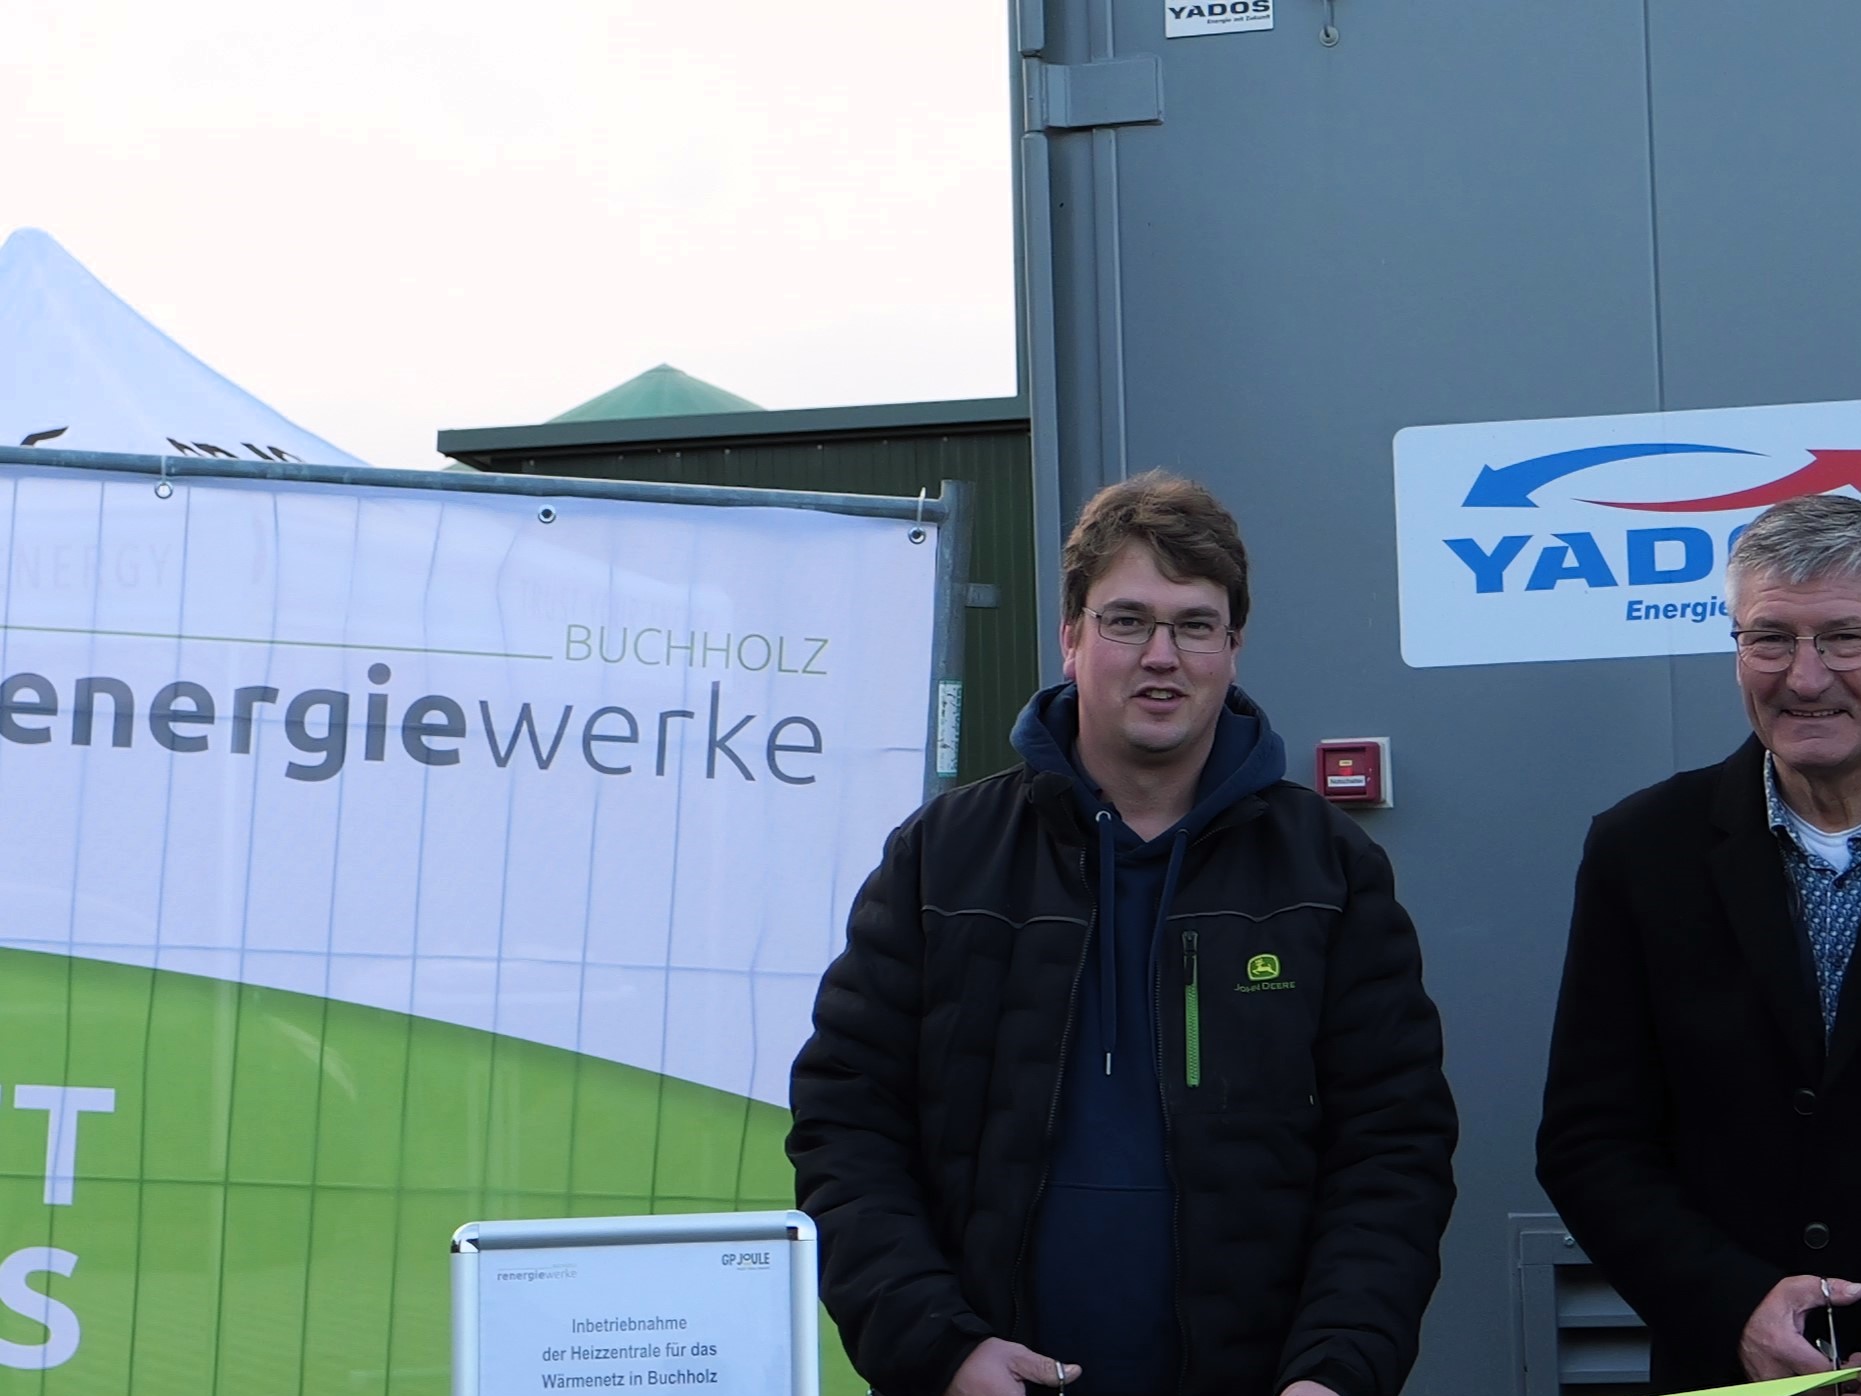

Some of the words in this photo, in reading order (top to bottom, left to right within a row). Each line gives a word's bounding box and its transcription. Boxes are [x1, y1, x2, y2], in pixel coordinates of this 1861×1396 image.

[1168, 0, 1270, 19] YADOS
[1442, 524, 1749, 594] YAD
[564, 623, 830, 676] BUCHHOLZ
[0, 662, 824, 786] energiewerke
[1262, 981, 1296, 991] DEERE
[721, 1253, 736, 1266] GP
[737, 1252, 771, 1265] JOULE
[496, 1268, 578, 1283] renergiewerke
[571, 1315, 688, 1334] Inbetriebnahme
[542, 1347, 566, 1362] der
[570, 1343, 661, 1361] Heizzentrale
[664, 1341, 687, 1358] für
[690, 1341, 718, 1357] das
[542, 1371, 625, 1389] Wärmenetz
[629, 1370, 643, 1386] in
[647, 1368, 718, 1386] Buchholz
